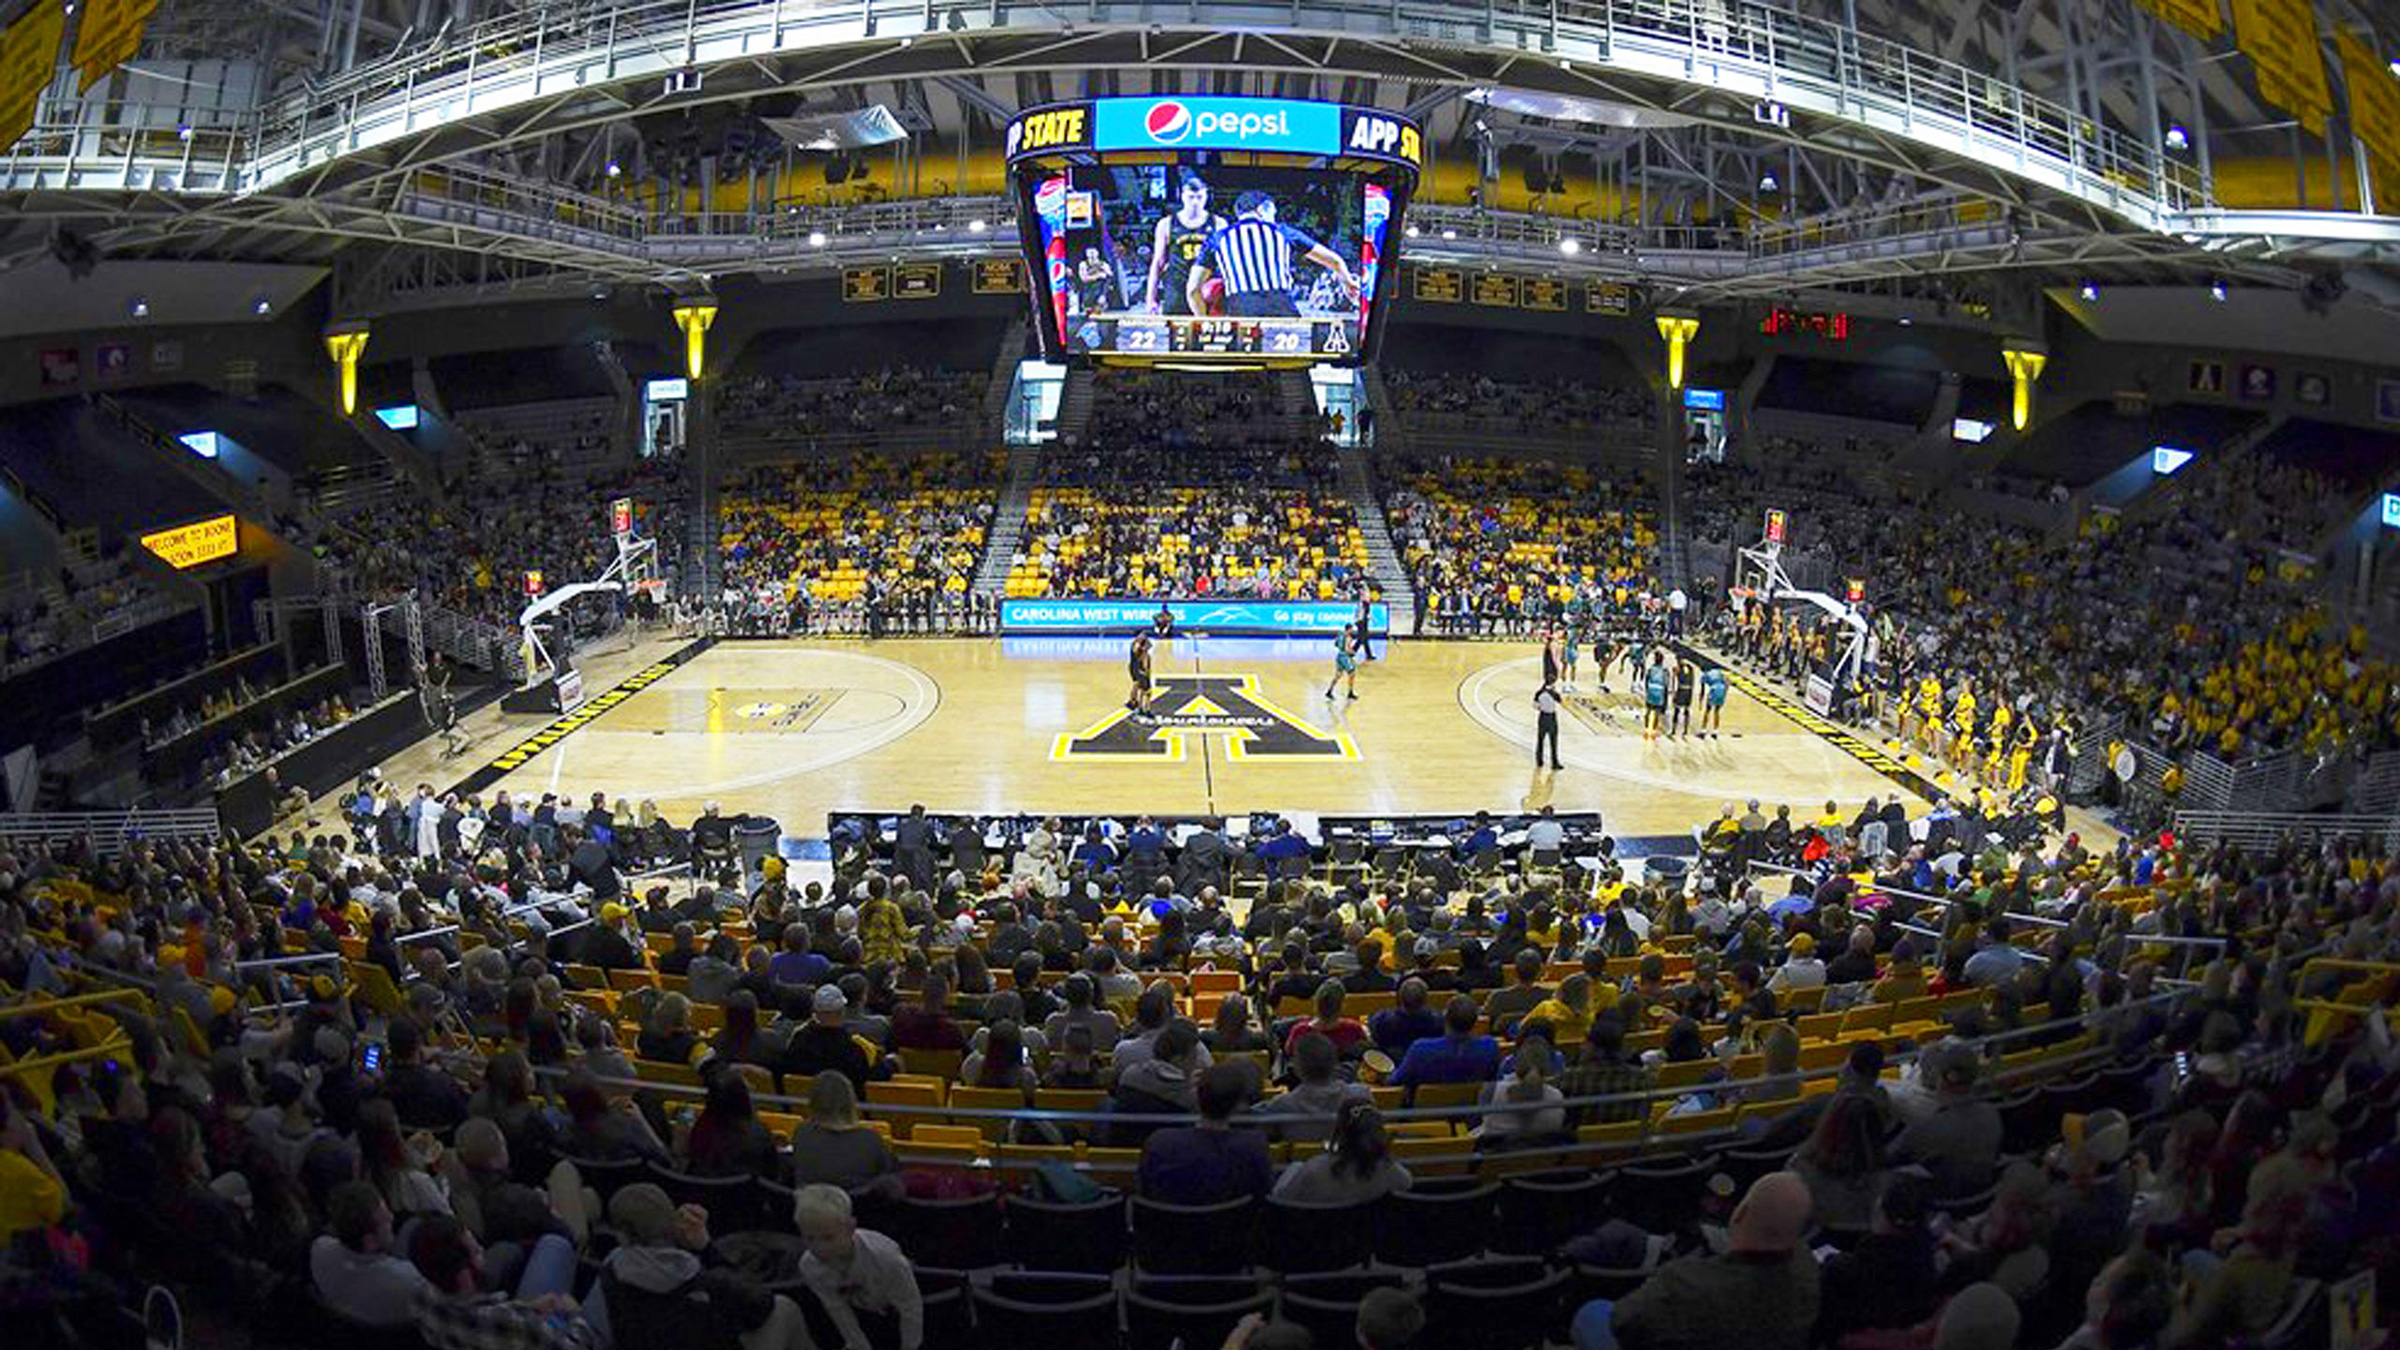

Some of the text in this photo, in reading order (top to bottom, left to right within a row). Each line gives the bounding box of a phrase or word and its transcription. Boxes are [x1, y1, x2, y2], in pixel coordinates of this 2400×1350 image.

[1023, 109, 1085, 150] STATE
[1196, 109, 1289, 139] pepsi
[1350, 116, 1399, 153] APP
[1129, 331, 1157, 349] 22
[1273, 332, 1300, 349] 20
[1012, 607, 1081, 621] CAROLINA
[1083, 608, 1119, 621] WEST
[1273, 609, 1290, 622] Go
[1292, 611, 1315, 626] stay
